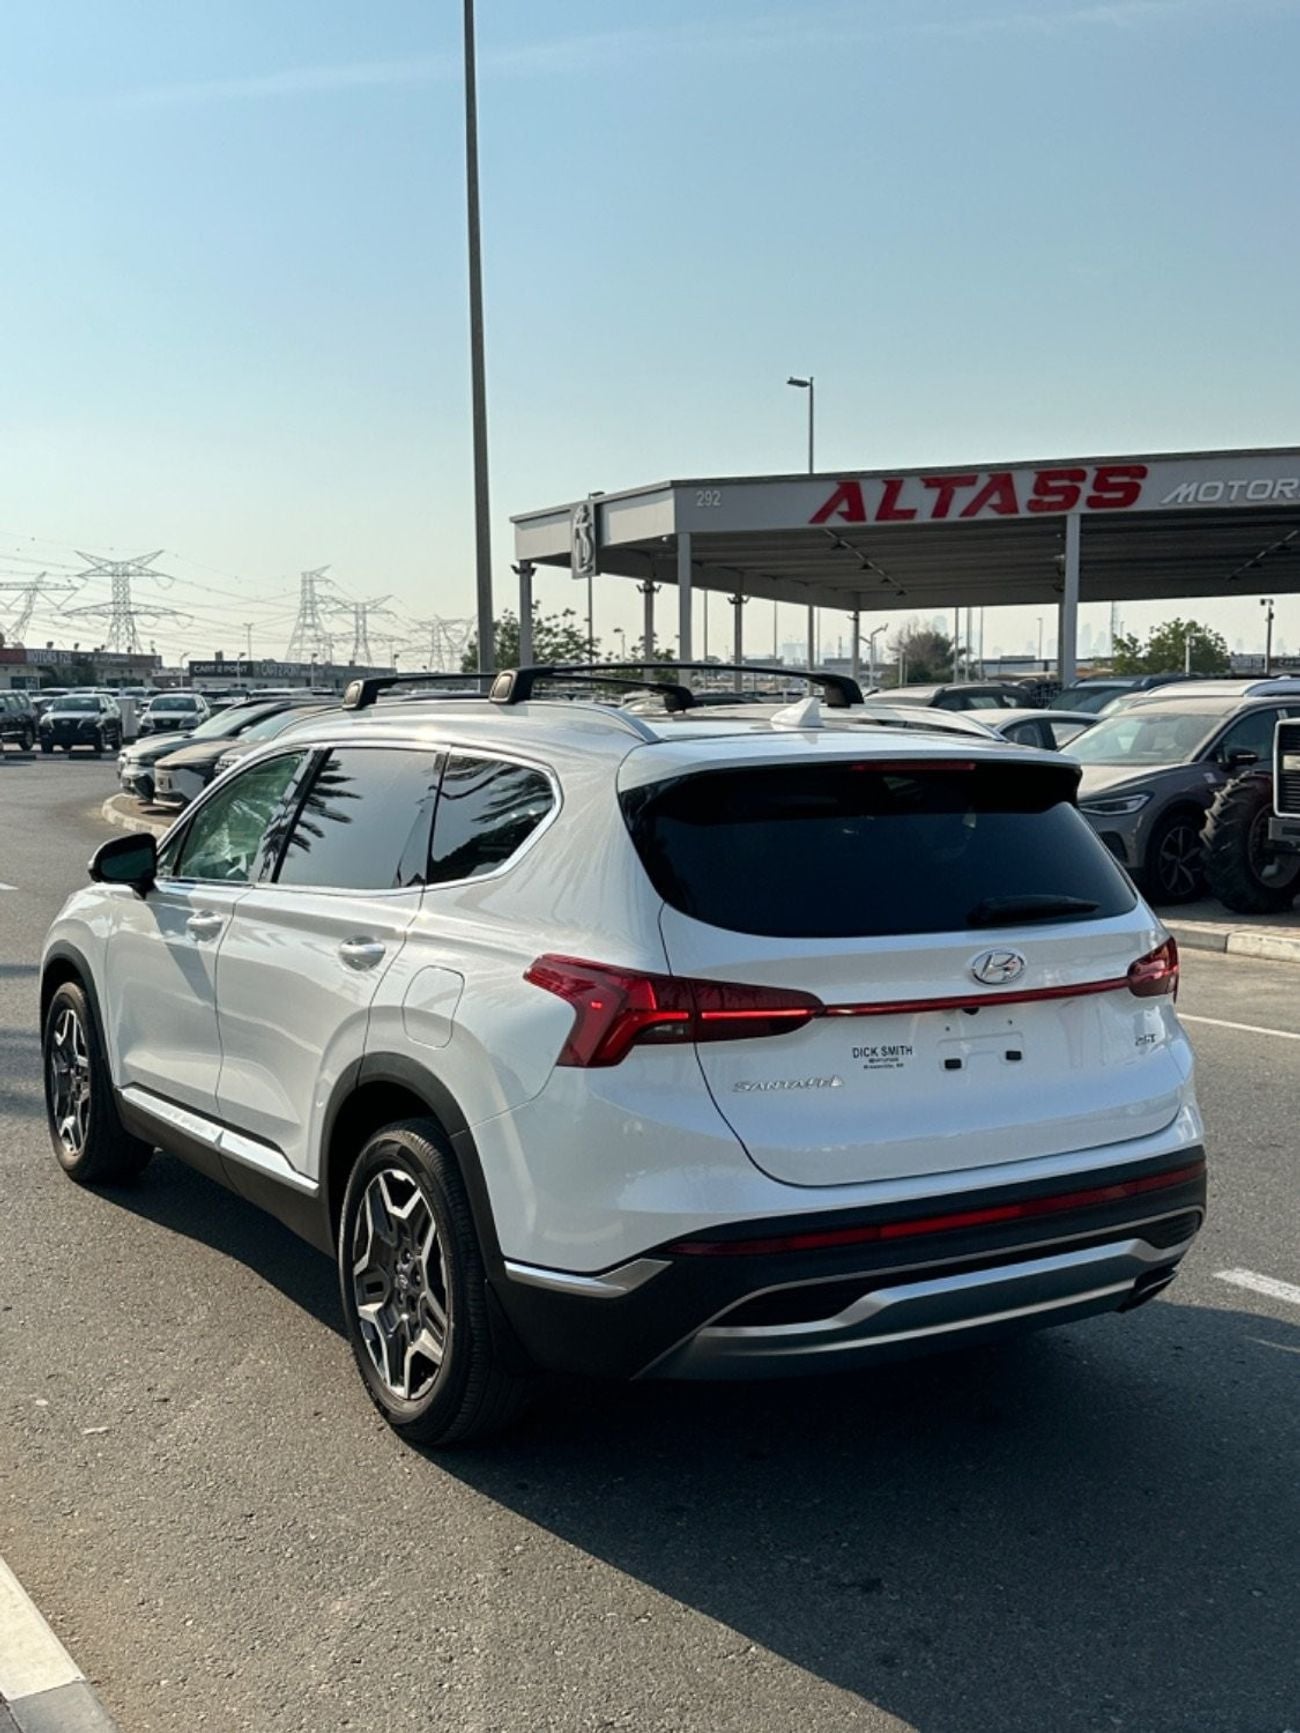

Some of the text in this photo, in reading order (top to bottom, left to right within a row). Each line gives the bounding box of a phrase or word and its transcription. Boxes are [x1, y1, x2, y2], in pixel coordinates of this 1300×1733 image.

[697, 490, 721, 506] 292
[809, 465, 1300, 524] ALTASS MOTOR
[224, 665, 248, 673] PONT
[852, 1045, 913, 1058] DICK SMITH
